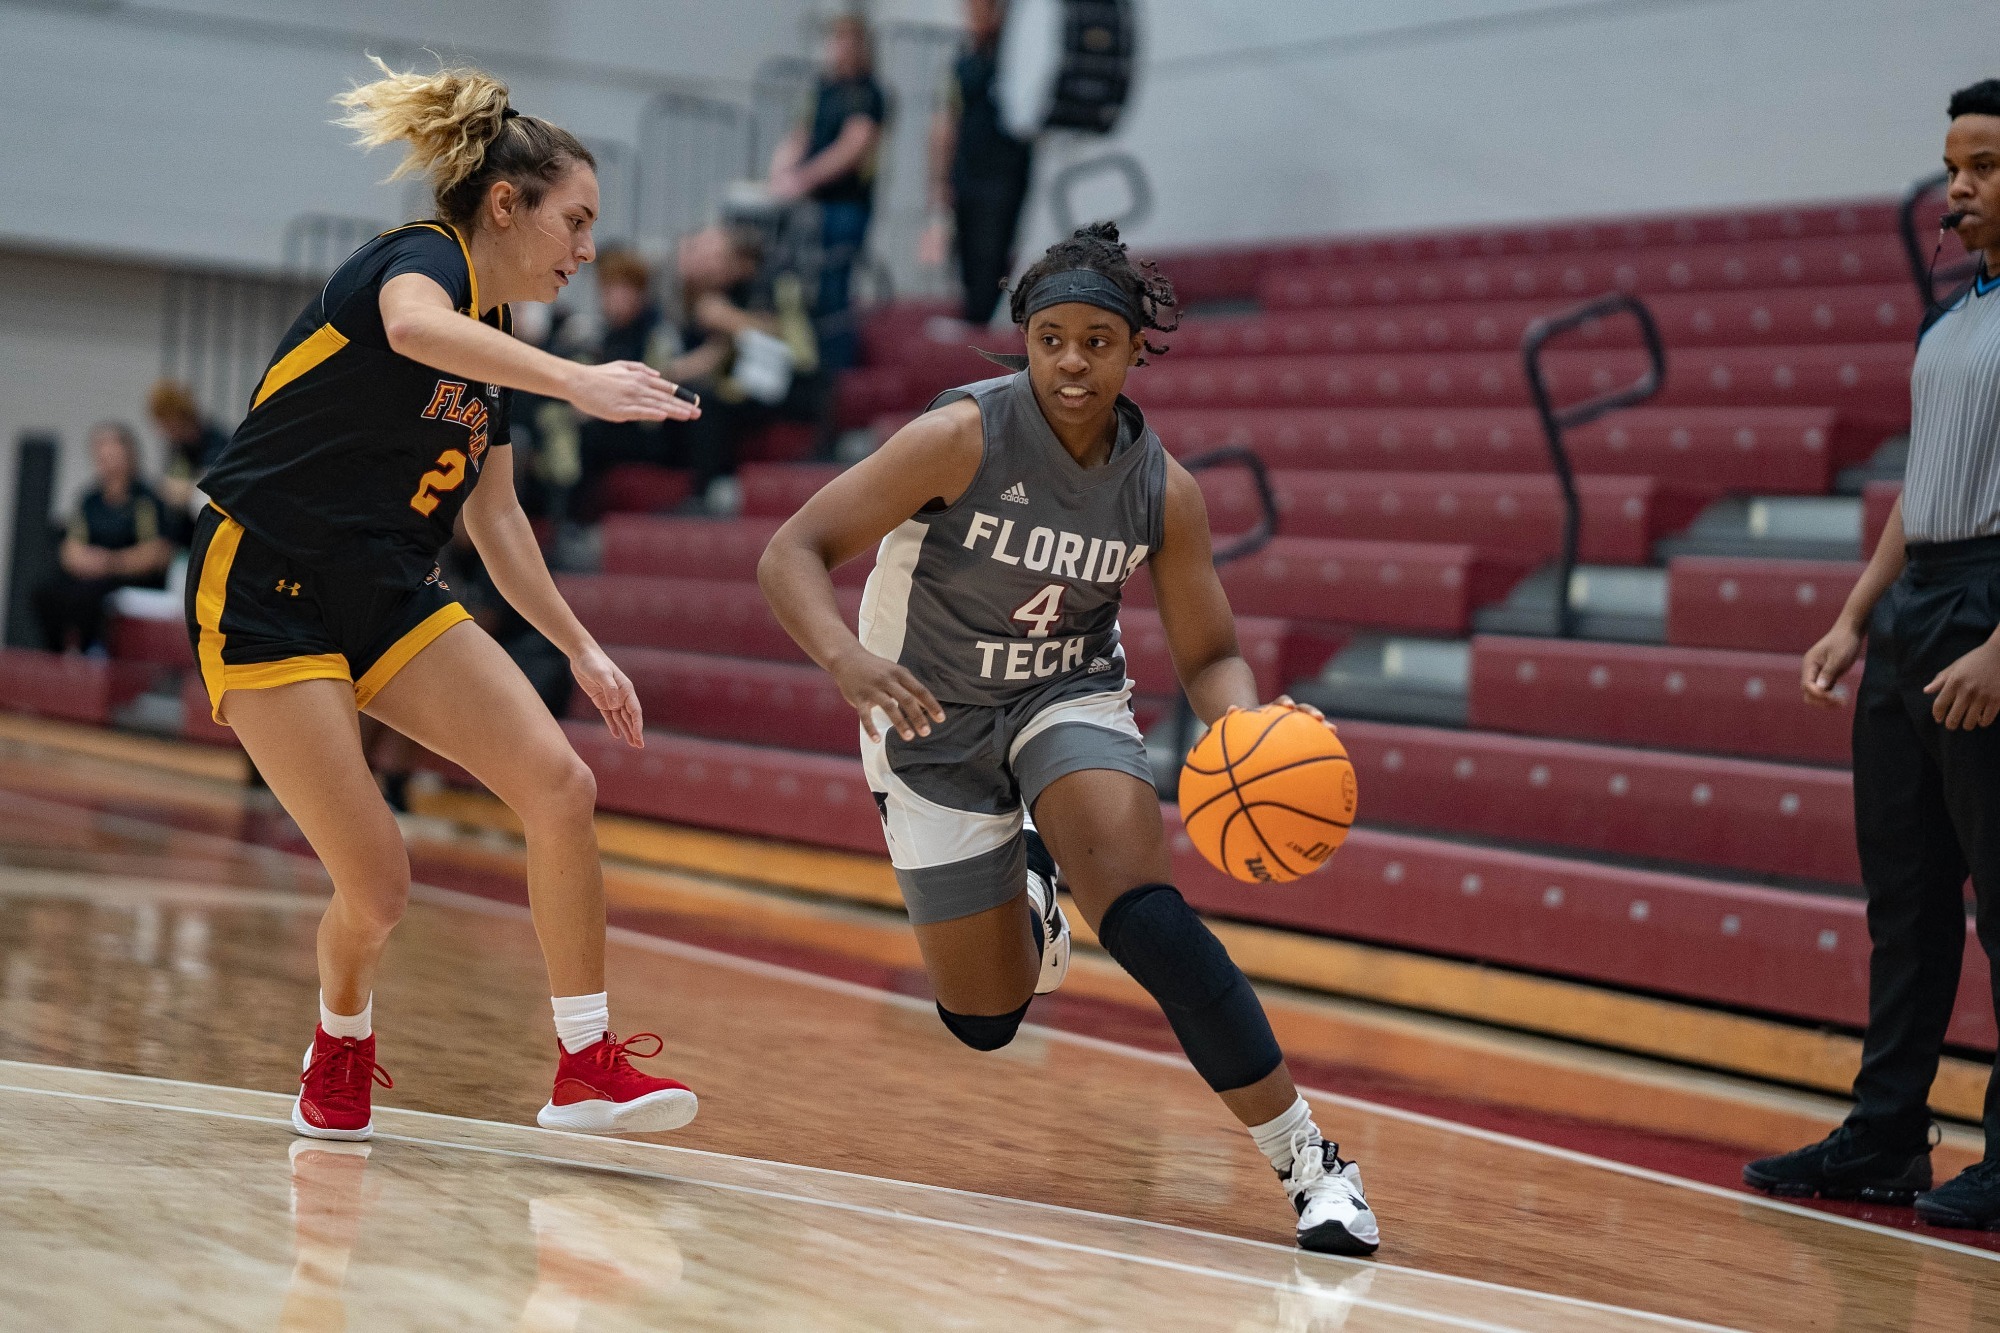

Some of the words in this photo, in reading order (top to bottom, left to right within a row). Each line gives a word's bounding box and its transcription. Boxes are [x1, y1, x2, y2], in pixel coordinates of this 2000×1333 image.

[410, 448, 467, 518] 2
[1001, 493, 1029, 505] adidas
[962, 511, 1149, 587] FLORIDA
[1010, 583, 1068, 638] 4
[975, 636, 1085, 680] TECH
